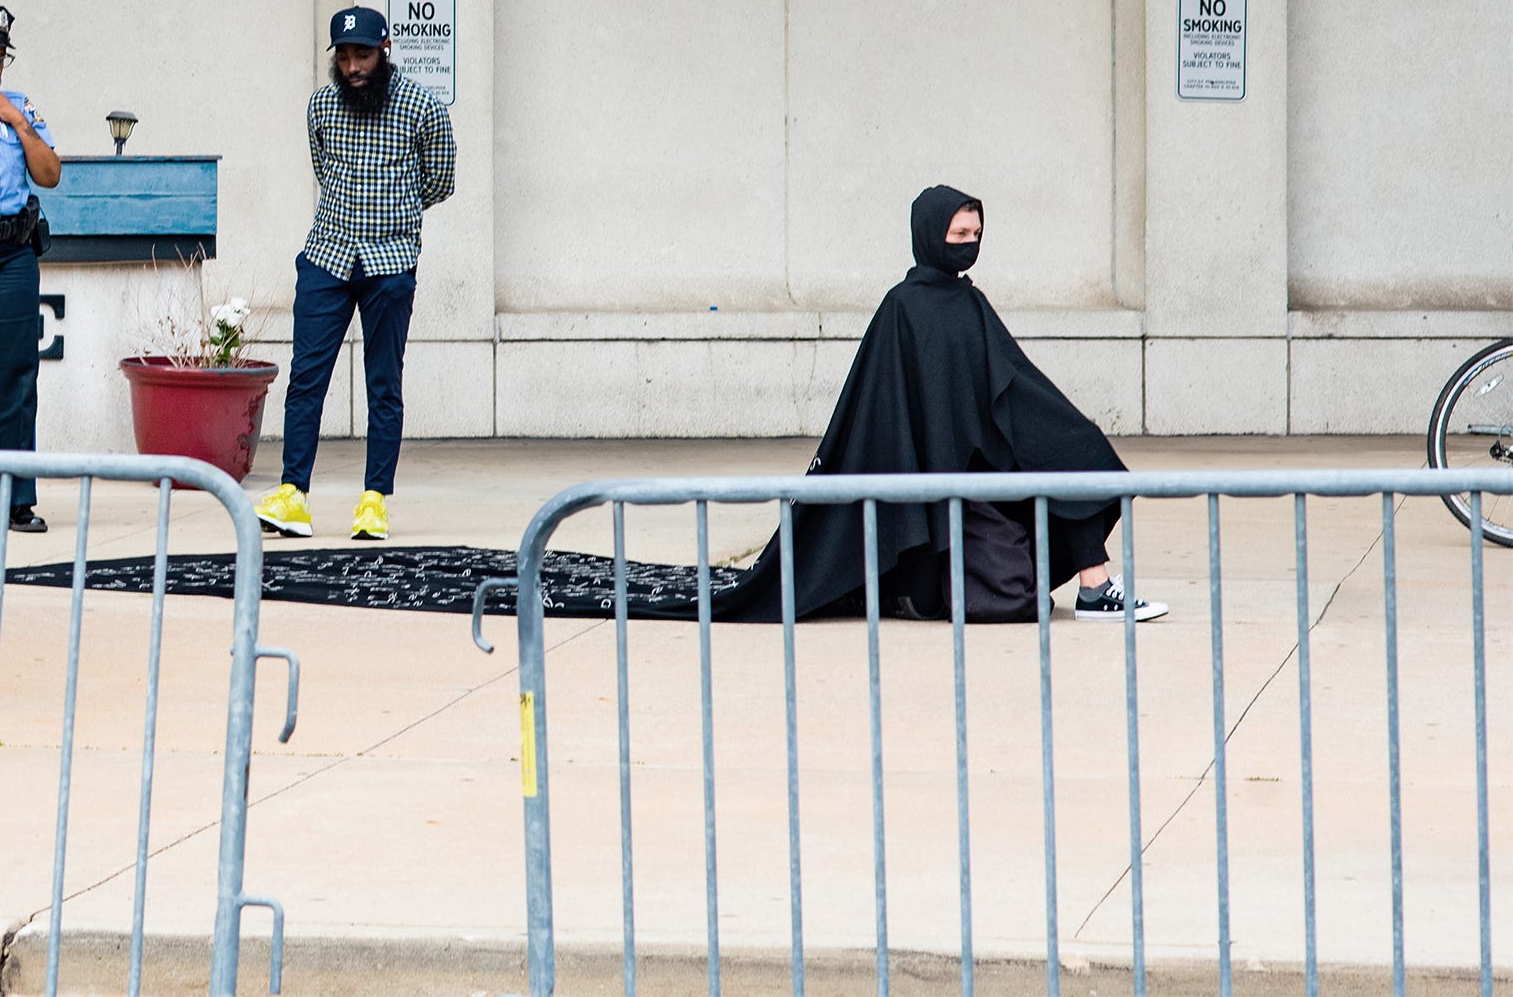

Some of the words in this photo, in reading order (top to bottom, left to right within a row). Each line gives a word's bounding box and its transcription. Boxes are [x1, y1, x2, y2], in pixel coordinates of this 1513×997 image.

[408, 2, 435, 20] NO
[343, 14, 357, 32] D
[392, 23, 451, 37] SMOKING
[1183, 19, 1242, 33] SMOKING
[403, 57, 440, 65] VIOLATORS
[1193, 52, 1231, 60] VIOLATORS
[1182, 60, 1212, 68] SUBJECT
[1226, 61, 1241, 69] FINE
